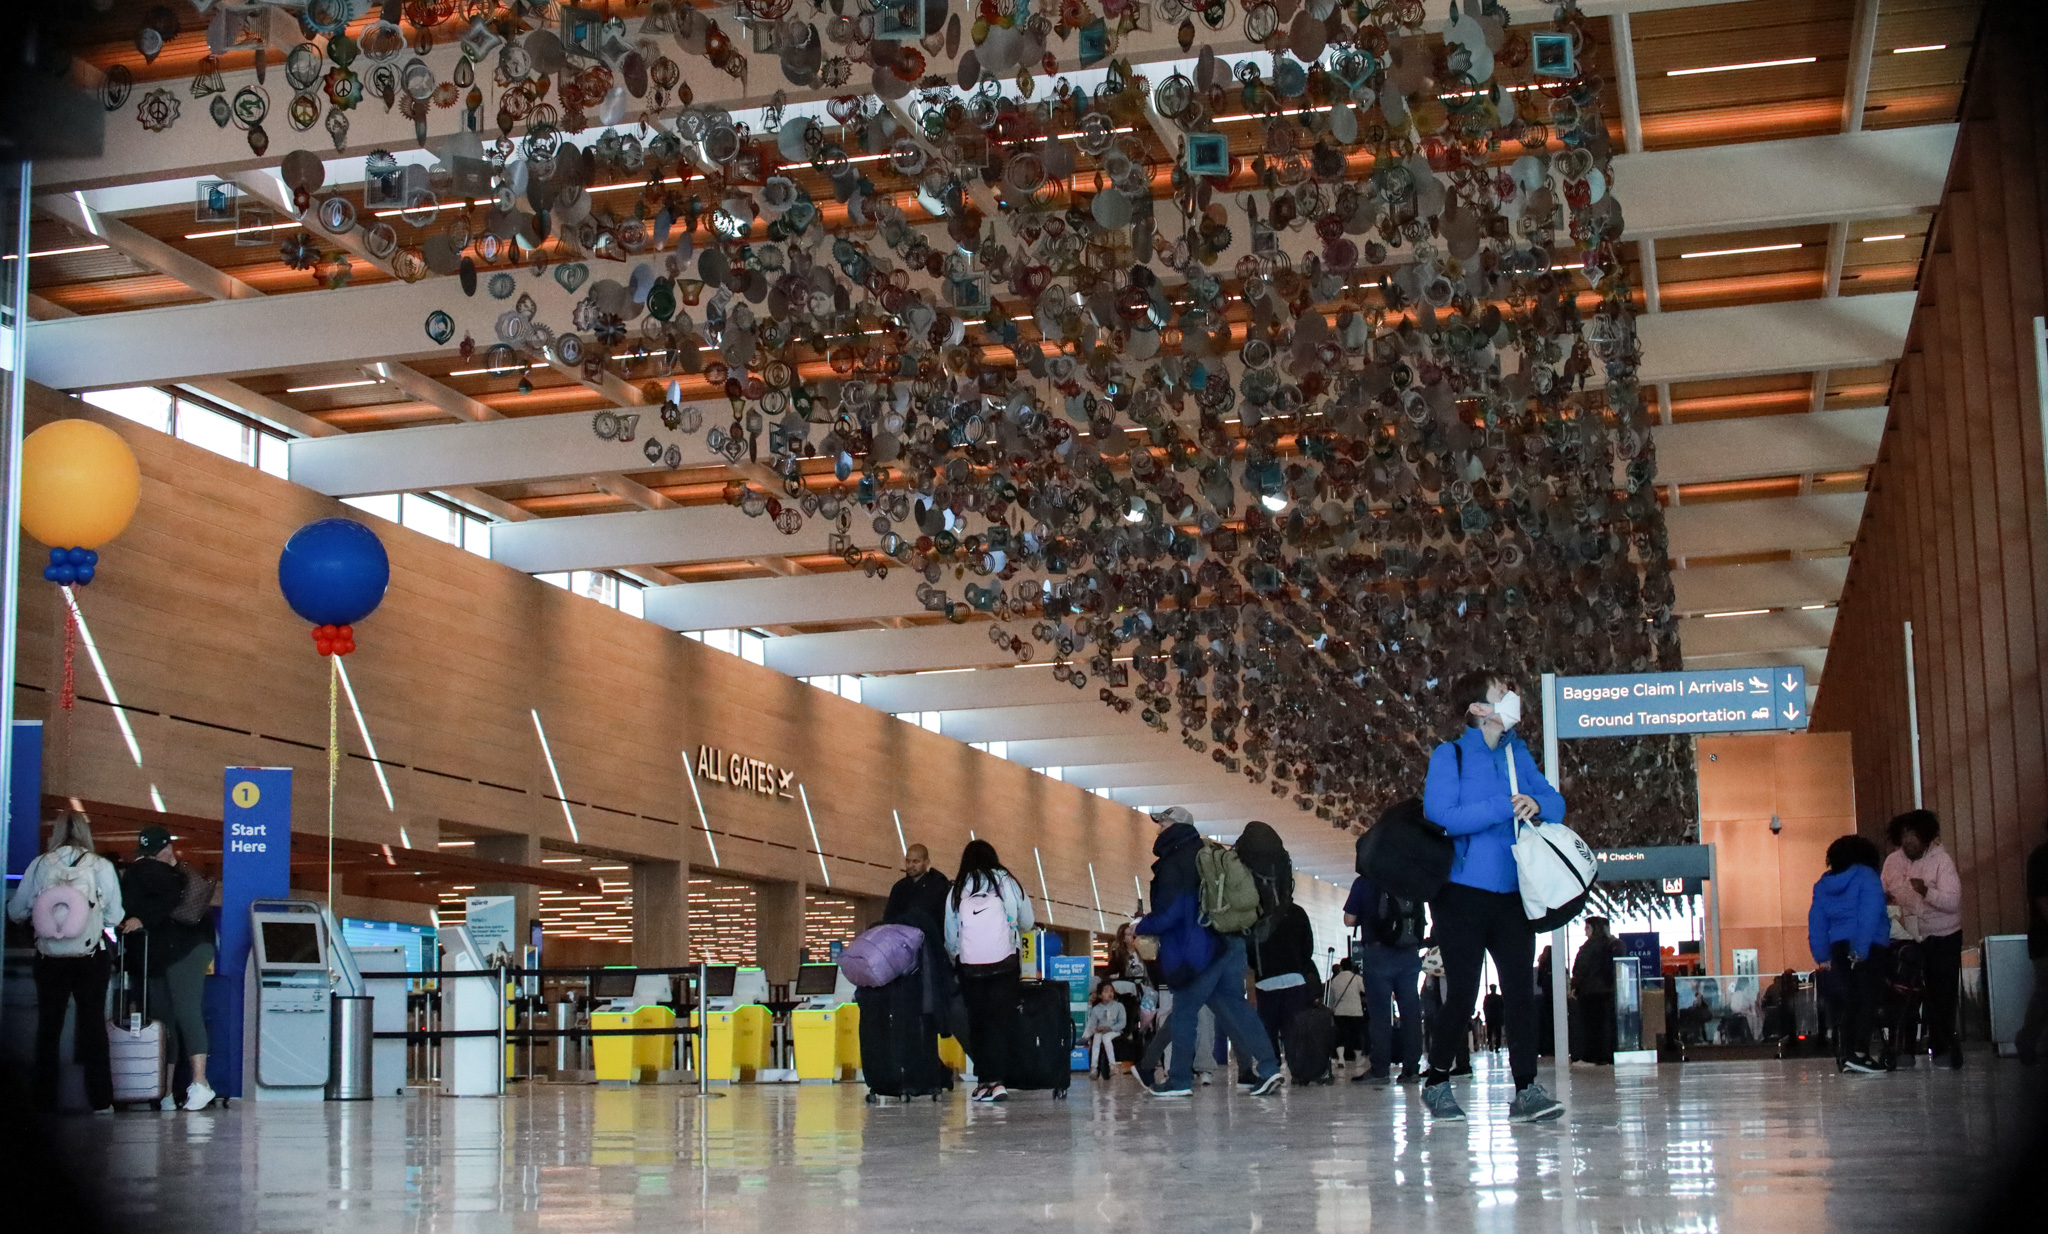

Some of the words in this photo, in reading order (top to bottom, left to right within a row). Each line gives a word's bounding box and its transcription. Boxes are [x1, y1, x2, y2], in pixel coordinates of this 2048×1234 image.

[1563, 686, 1629, 701] Baggage
[1633, 683, 1675, 697] Claim
[1688, 679, 1745, 694] Arrivals
[1578, 712, 1633, 727] Ground
[1637, 708, 1746, 726] Transportation
[697, 744, 727, 783] ALL
[730, 753, 775, 795] GATES
[242, 788, 249, 802] 1
[231, 823, 267, 836] Start
[231, 840, 267, 853] Here
